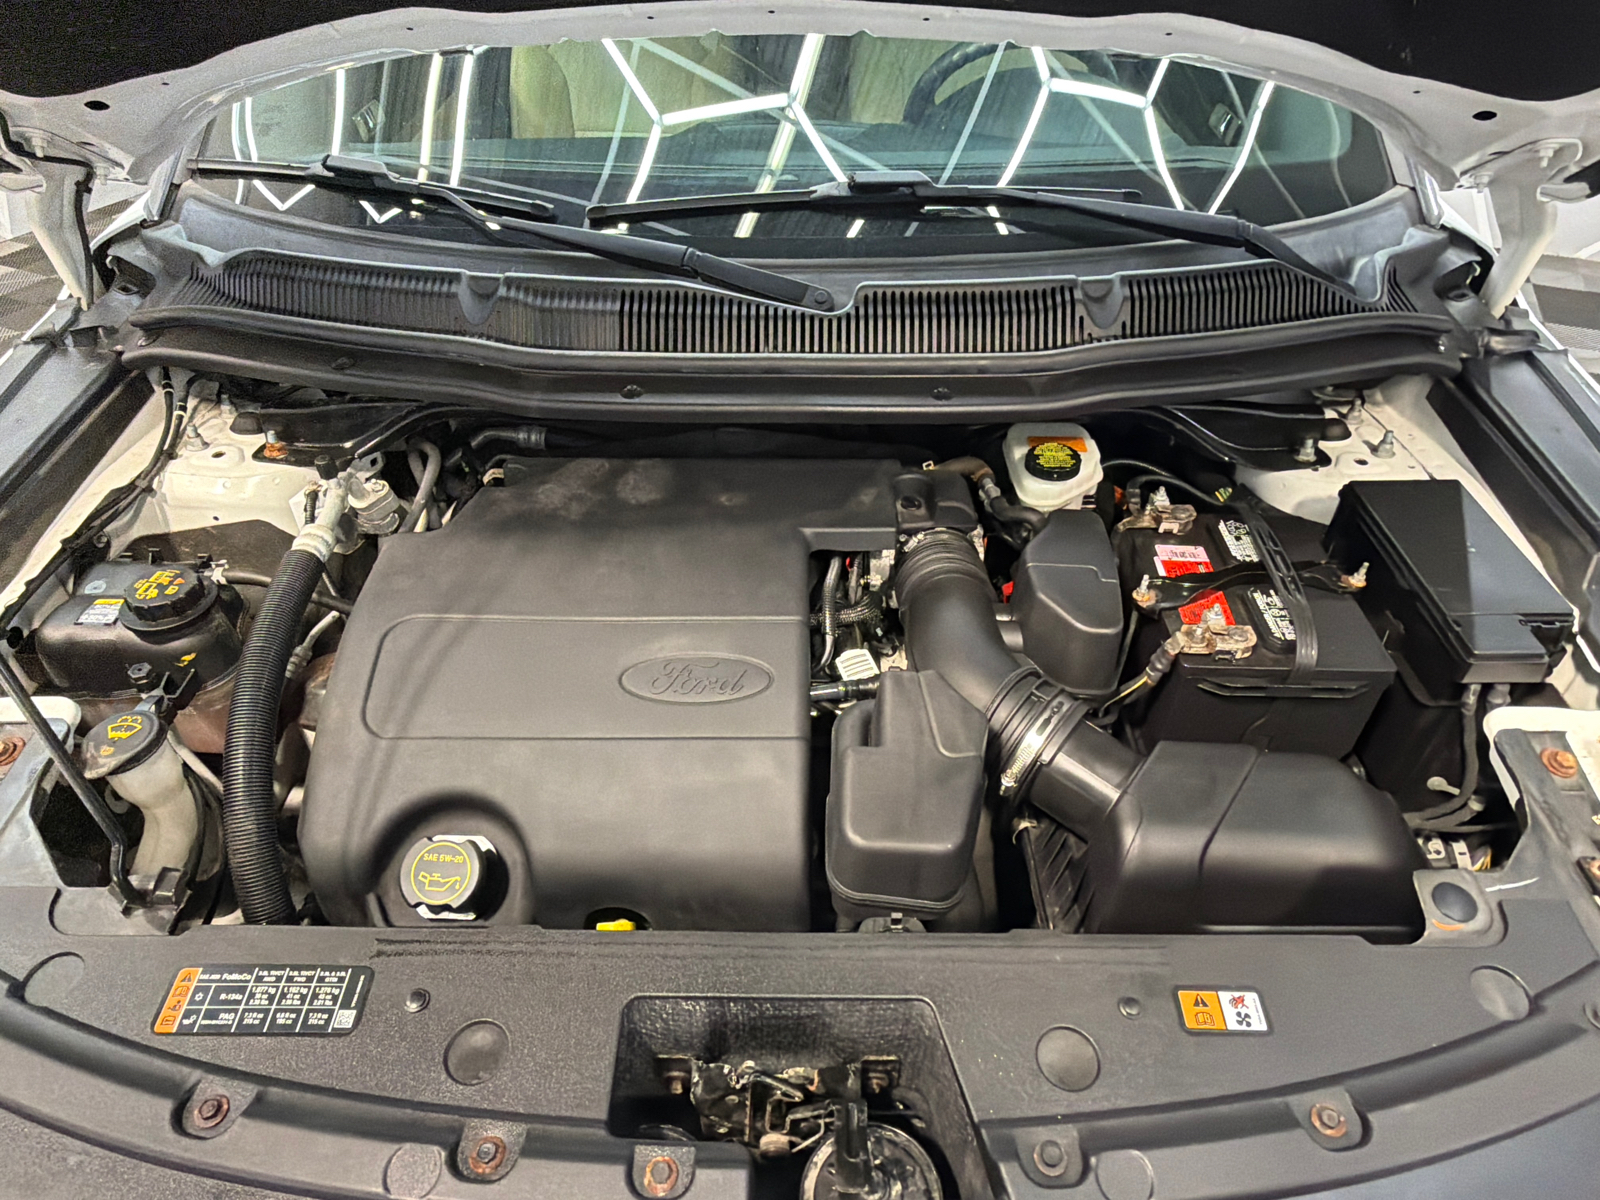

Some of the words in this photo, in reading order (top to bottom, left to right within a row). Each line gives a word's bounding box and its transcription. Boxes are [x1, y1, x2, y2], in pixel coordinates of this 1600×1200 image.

[651, 661, 748, 695] Ford
[423, 853, 438, 862] SAE
[439, 854, 464, 864] 5W-20
[222, 973, 252, 981] FoMoCo
[331, 987, 340, 995] kg
